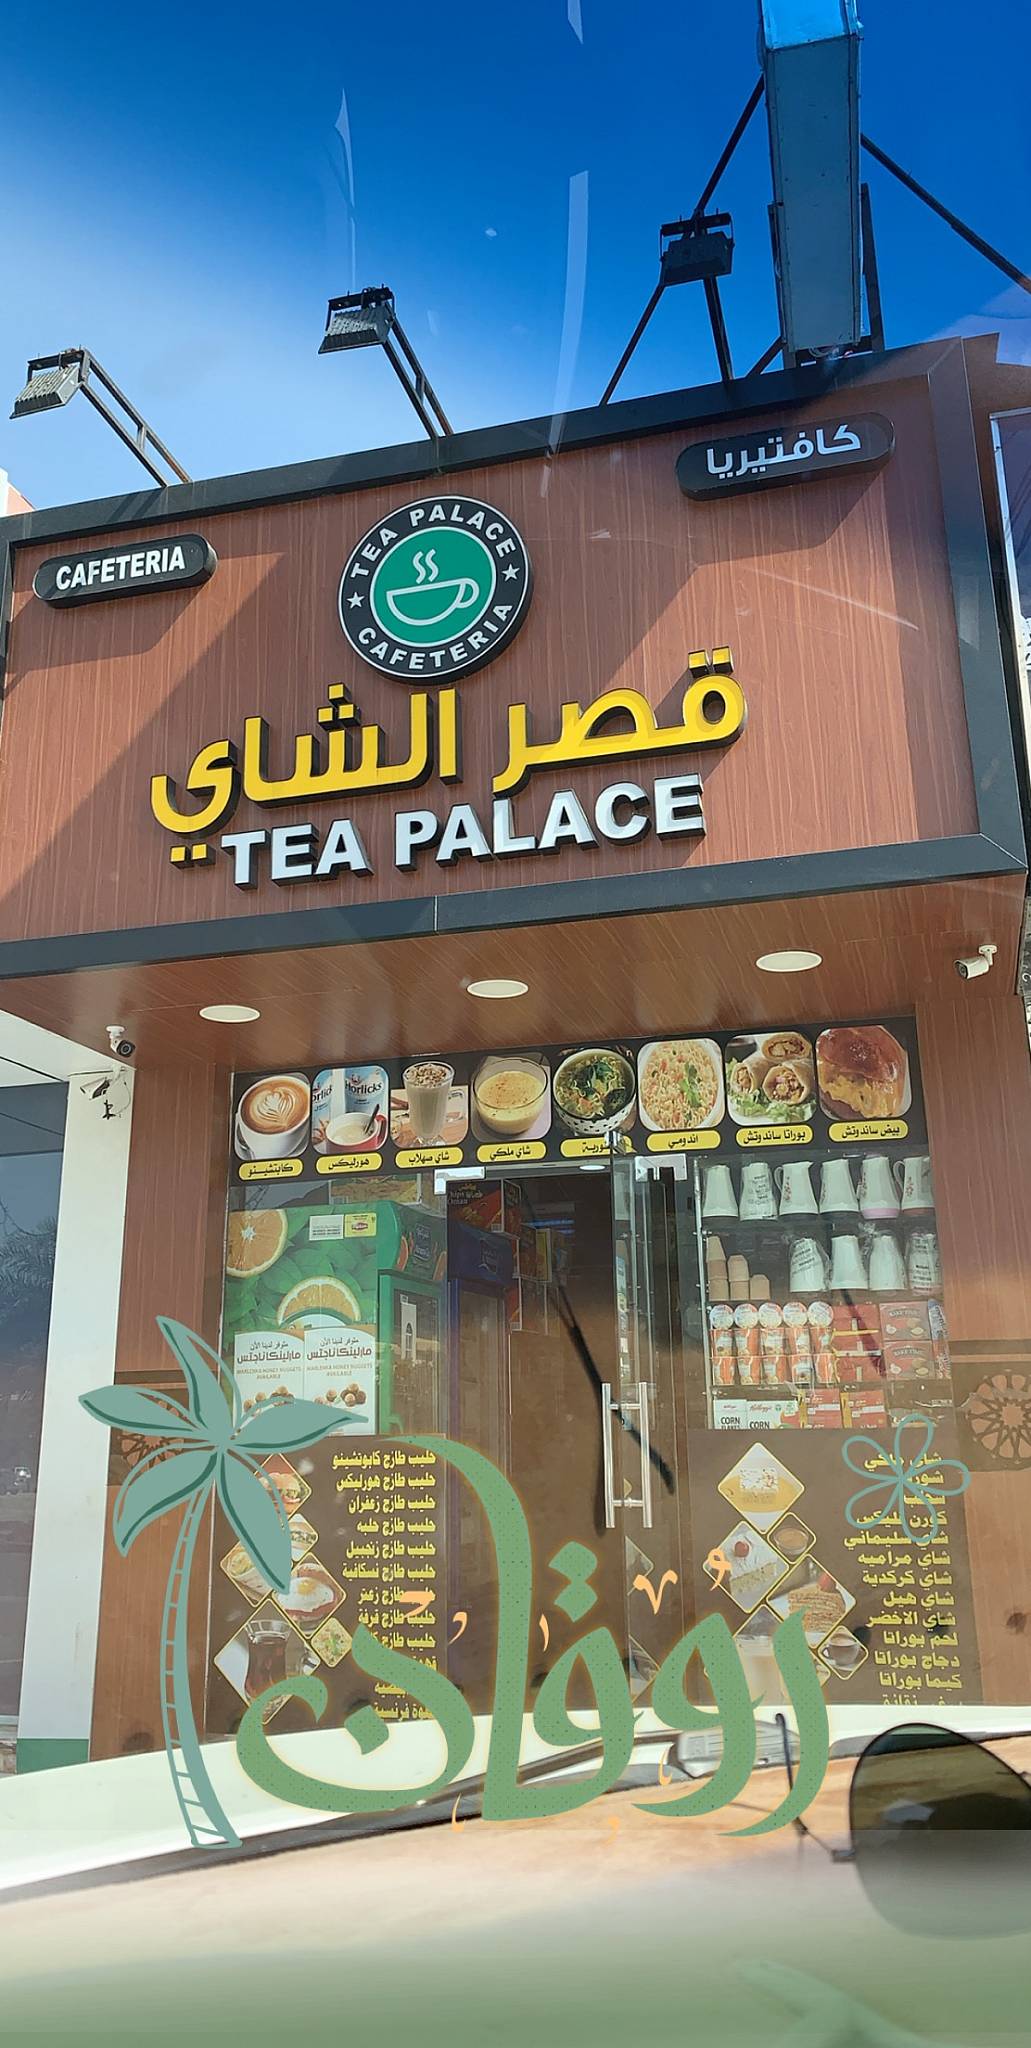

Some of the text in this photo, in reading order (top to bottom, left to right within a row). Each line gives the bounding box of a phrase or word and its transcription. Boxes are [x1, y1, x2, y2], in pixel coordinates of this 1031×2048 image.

[706, 424, 862, 480] كافتيريا
[351, 504, 517, 579] TEA PALACE
[55, 546, 186, 591] CAFETERIA
[357, 603, 513, 670] CAFETERIA
[150, 646, 749, 866] قصر الشاي
[221, 772, 707, 888] TEA PALACE
[784, 1129, 806, 1142] بوراتا
[880, 1123, 900, 1137] بيض
[435, 1150, 450, 1164] شاي
[489, 1146, 531, 1160] شاي ملكي
[328, 1157, 370, 1170] هورليكس
[720, 1416, 741, 1425] CORN
[383, 1450, 406, 1469] طازج
[408, 1449, 437, 1468] حليب
[336, 1472, 436, 1491] حليب طازج هورليكس
[348, 1494, 436, 1514] حليب طازج زعفران
[357, 1517, 436, 1536] حليب طازج حلبه
[346, 1540, 436, 1559] حليب طازج زنجبيل
[844, 1530, 912, 1551] سليماني
[858, 1550, 951, 1571] شاي مراميه
[382, 1563, 405, 1582] طازج
[407, 1563, 436, 1582] حليب
[862, 1570, 953, 1591] شاي كركدية
[883, 1591, 955, 1611] شاي هيل
[381, 1609, 405, 1628] طازج
[864, 1611, 956, 1632] شاي الاخضر
[406, 1632, 436, 1652] حليب
[883, 1630, 959, 1650] لحم بوراتا
[874, 1650, 961, 1670] دجاج بوراتا
[879, 1671, 963, 1692] كيما بوراتا
